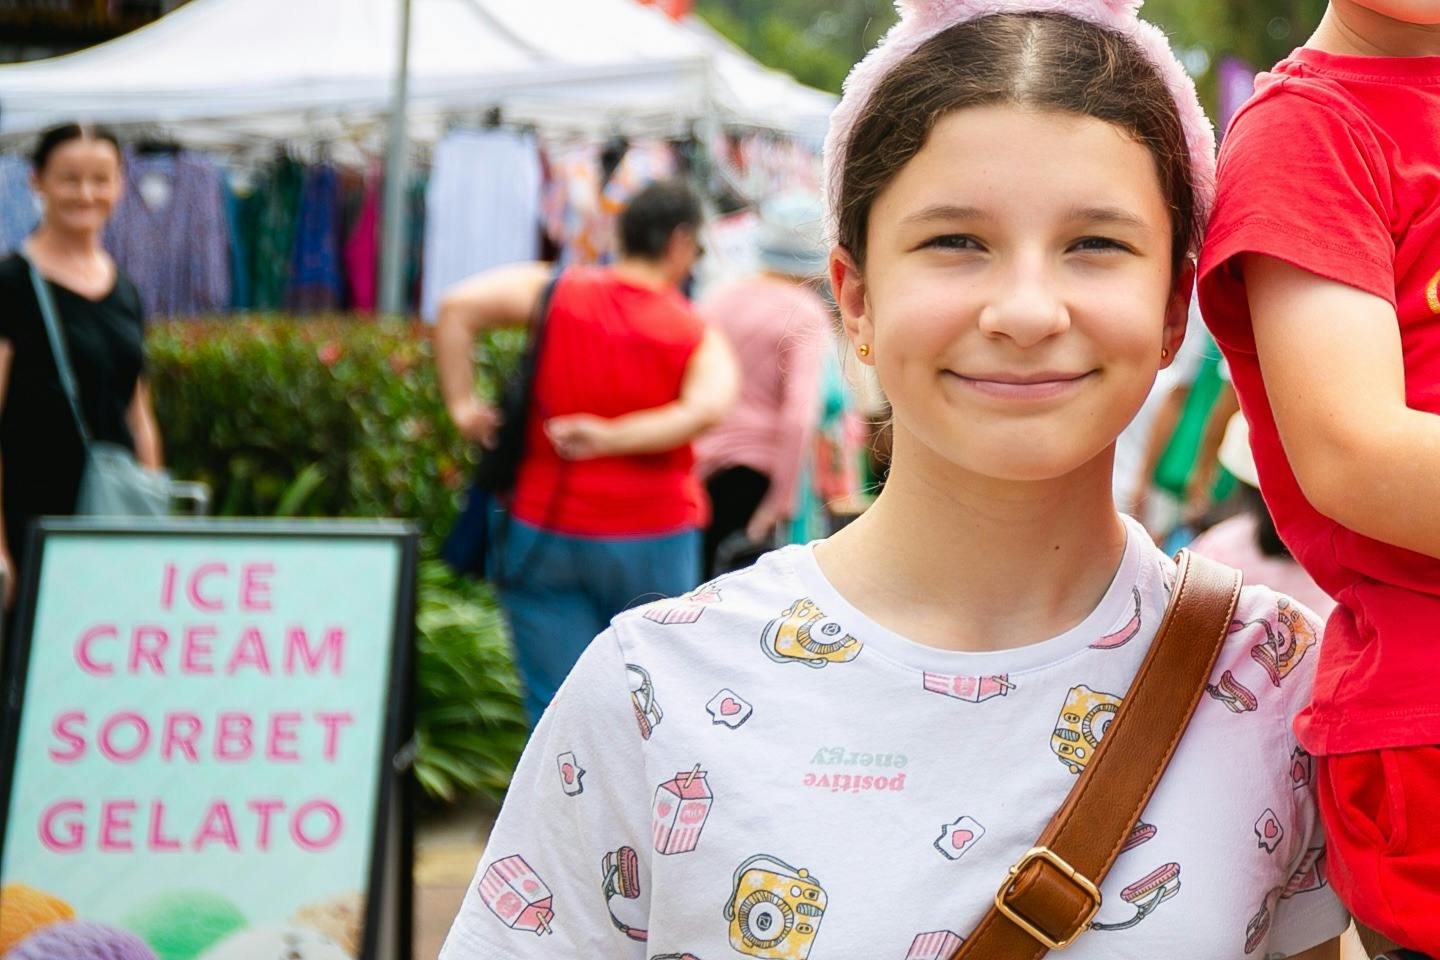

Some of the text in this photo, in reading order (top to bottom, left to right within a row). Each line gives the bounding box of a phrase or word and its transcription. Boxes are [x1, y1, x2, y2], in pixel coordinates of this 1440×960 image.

[160, 562, 277, 611] ICE
[73, 624, 347, 676] CREAM
[48, 711, 354, 764] SORBET
[809, 745, 908, 768] energy
[803, 773, 907, 793] positive
[38, 800, 345, 854] GELATO
